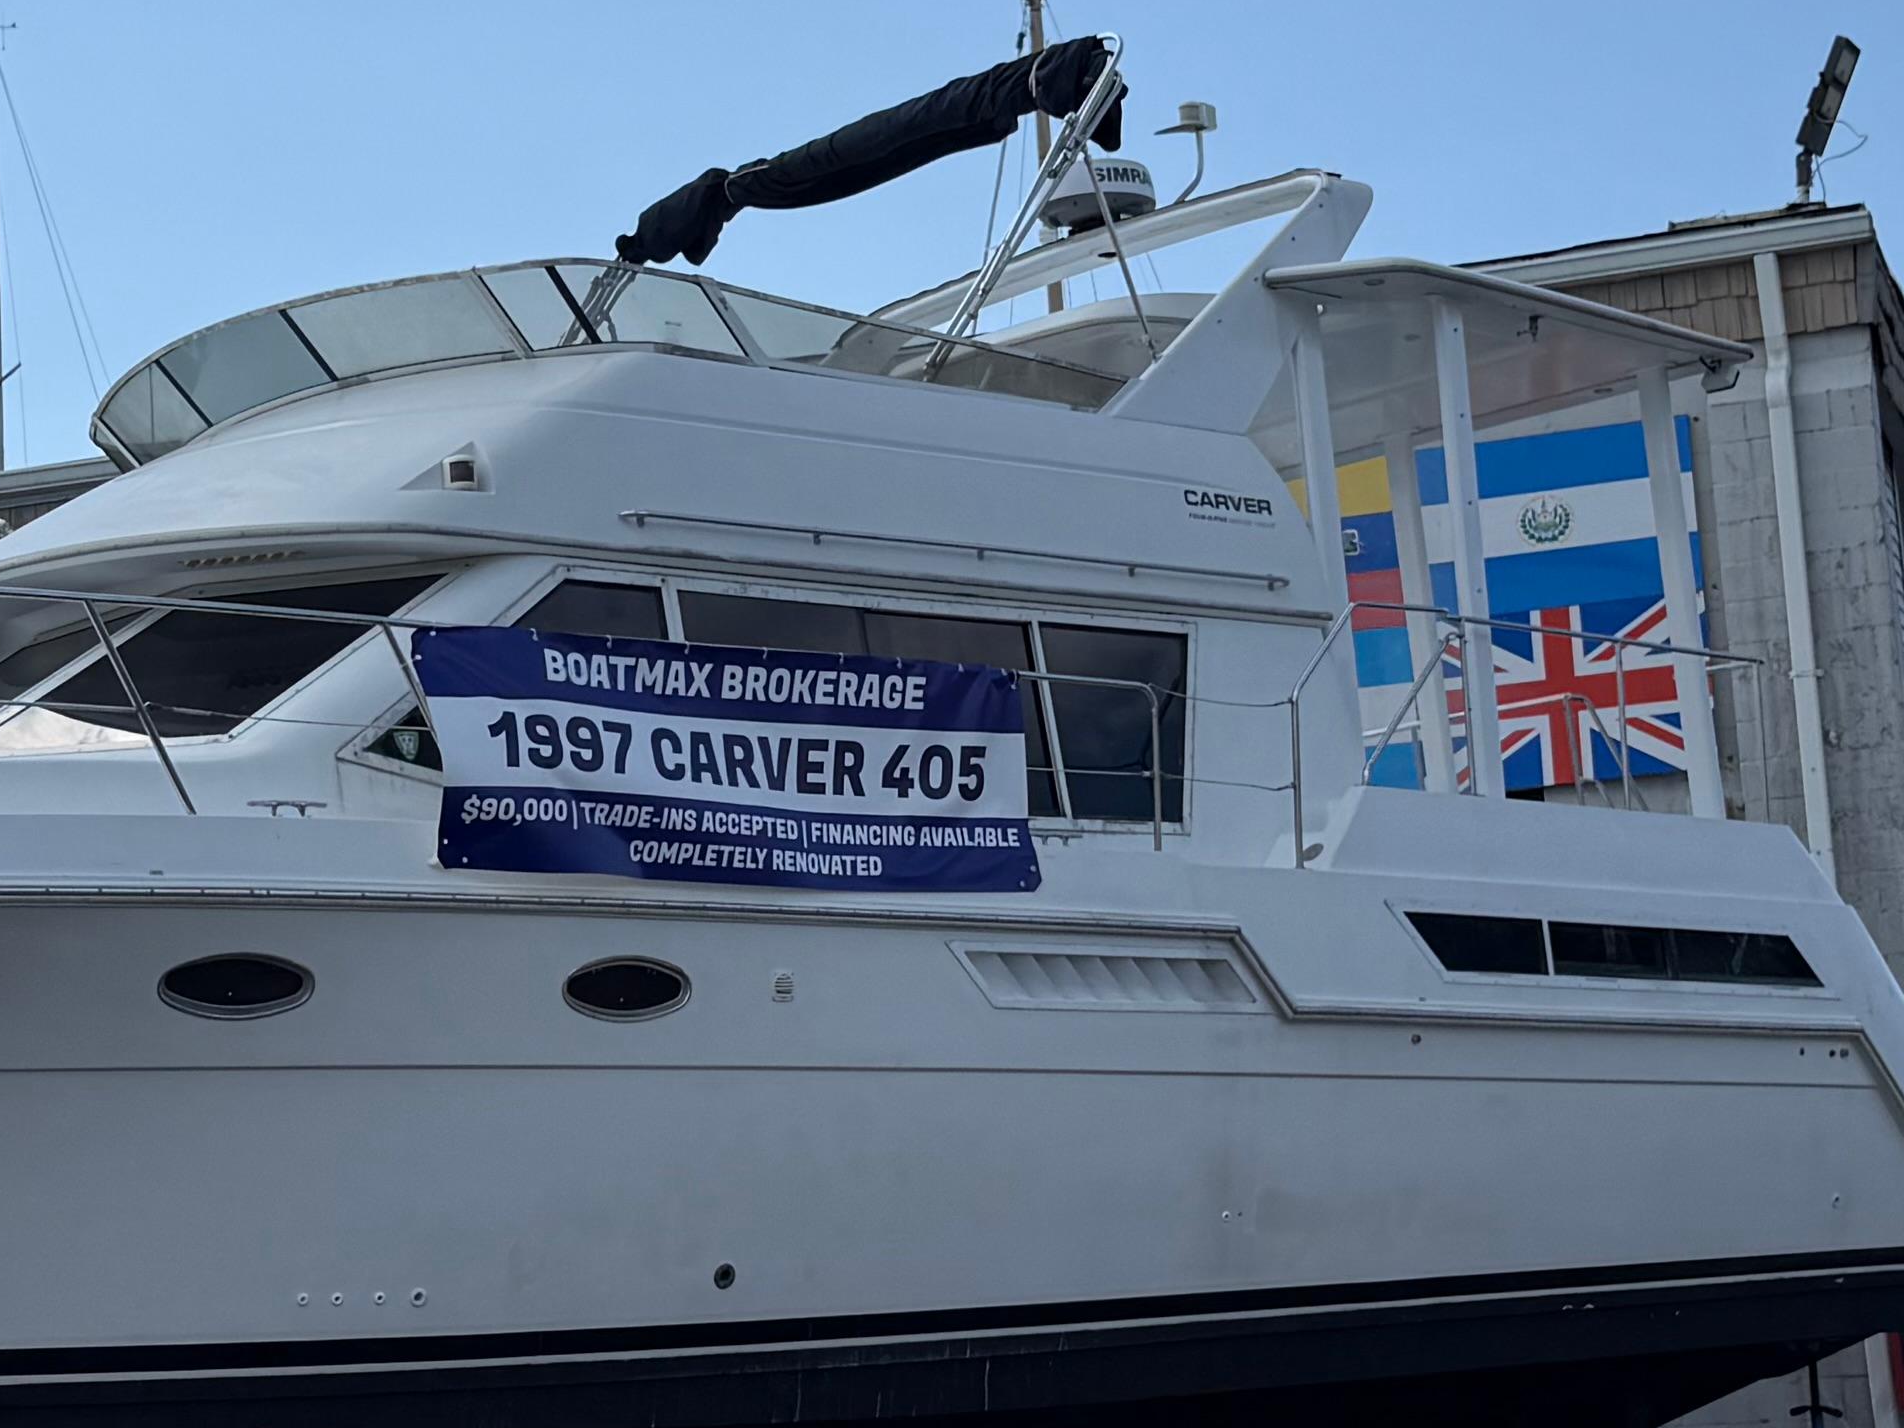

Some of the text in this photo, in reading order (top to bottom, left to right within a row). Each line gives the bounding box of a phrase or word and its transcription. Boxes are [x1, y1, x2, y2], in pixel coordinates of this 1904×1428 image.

[1183, 489, 1273, 516] CARVER
[543, 648, 927, 710] BOATMAX BROKERAGE
[487, 711, 988, 802] 1997 CARVER 405
[461, 794, 568, 826] $90,000
[580, 802, 697, 832] TRADE-INS
[701, 810, 798, 840] ACCEPTED
[811, 822, 916, 847] FINANCING
[919, 826, 1021, 848] AVAILABLE
[629, 840, 883, 877] COMPLETELY RENOVATED
